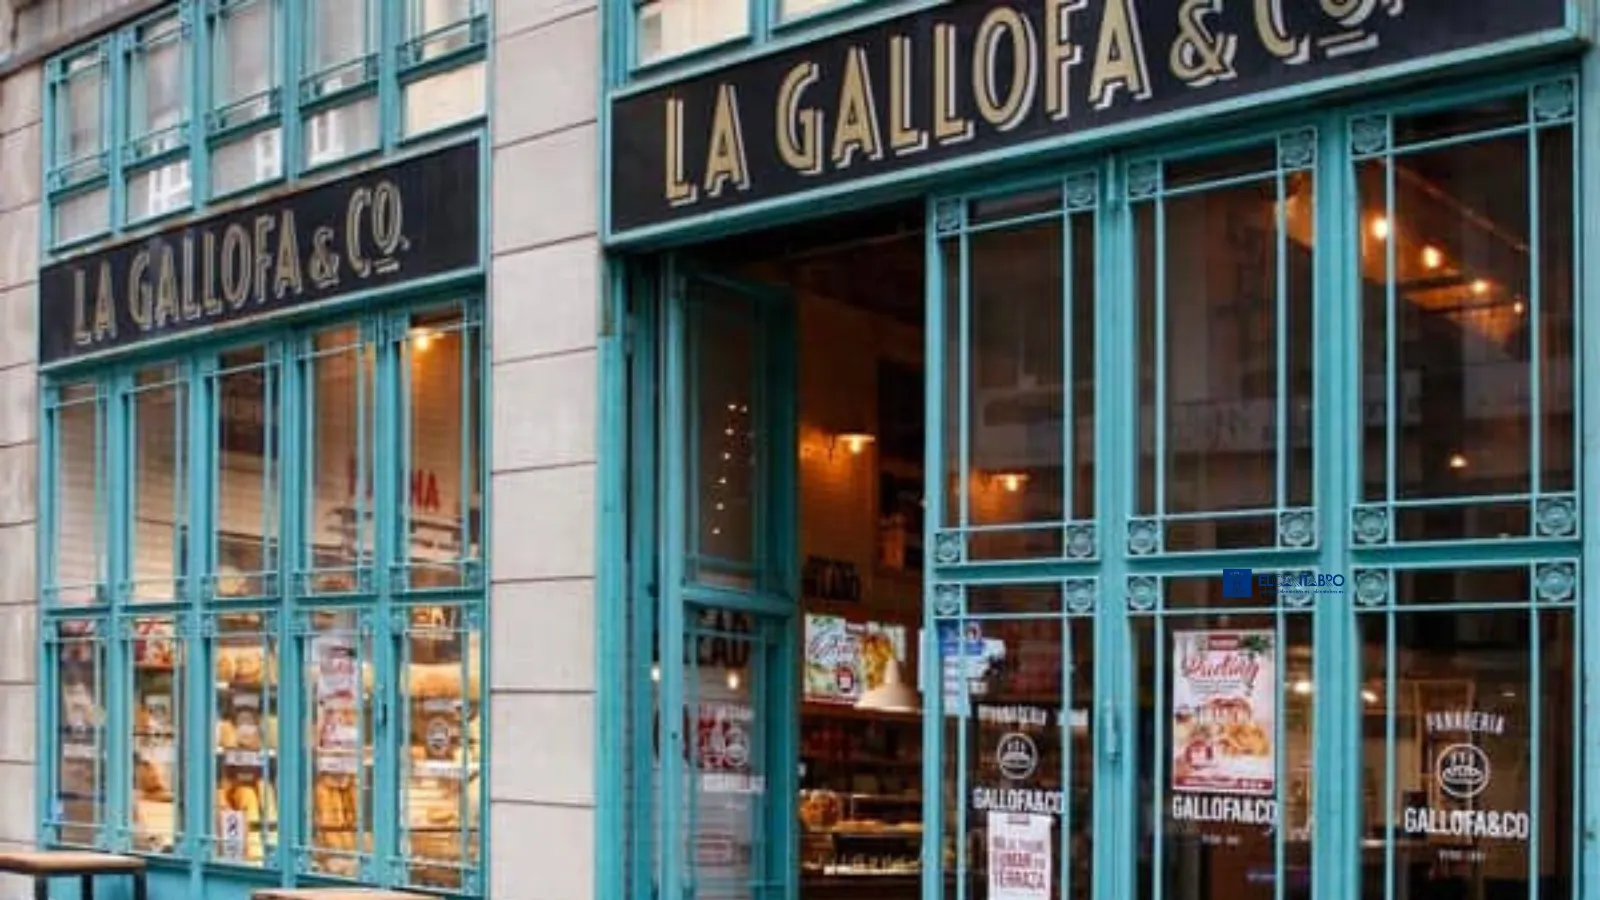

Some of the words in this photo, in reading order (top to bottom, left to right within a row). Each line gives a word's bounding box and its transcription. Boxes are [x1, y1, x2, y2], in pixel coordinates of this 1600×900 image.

[665, 83, 750, 207] LA
[775, 0, 1153, 175] GALLOFA
[73, 260, 117, 345] LA
[129, 210, 302, 331] GALLOFA
[309, 226, 340, 289] &
[1404, 807, 1530, 839] GALLOFA&CO
